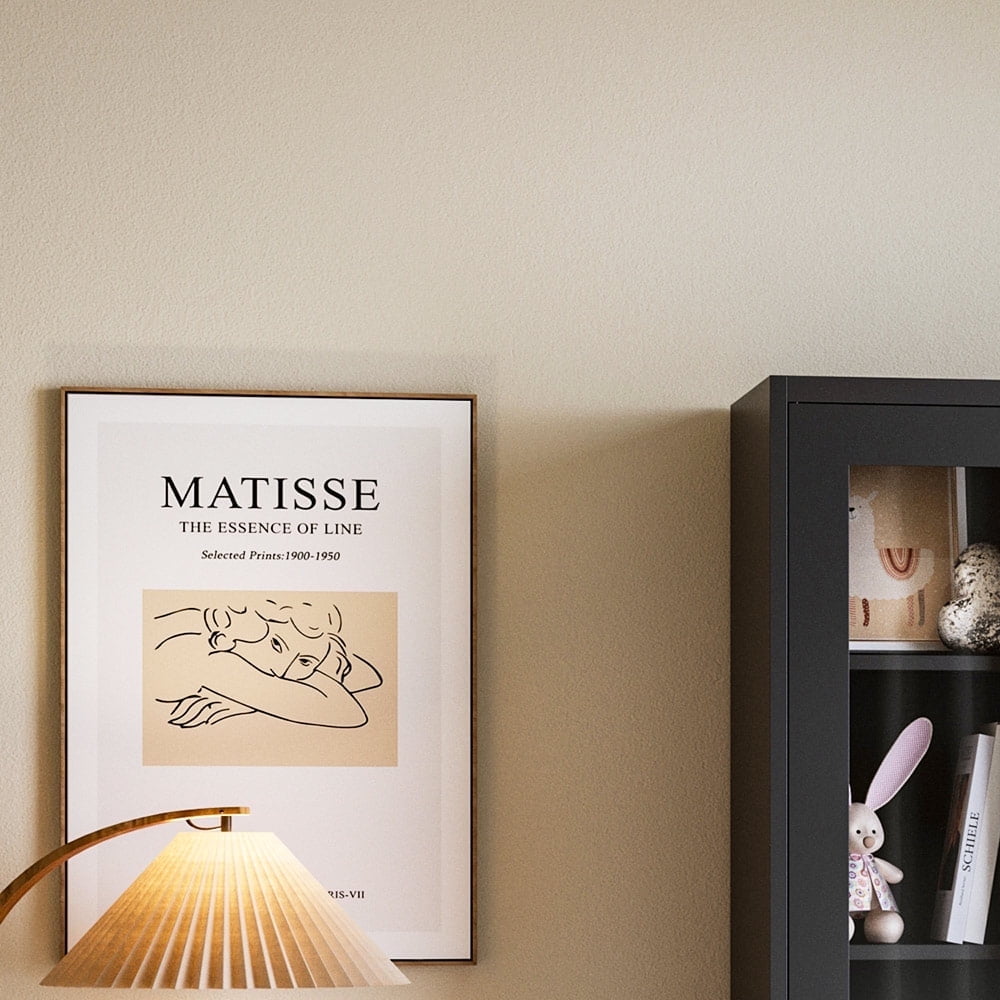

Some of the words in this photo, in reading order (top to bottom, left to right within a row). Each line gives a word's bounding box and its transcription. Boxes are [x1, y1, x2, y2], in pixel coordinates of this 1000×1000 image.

[161, 475, 381, 511] MATISSE
[179, 521, 212, 533] THE
[218, 521, 292, 535] ESSENCE
[297, 522, 319, 535] OF
[324, 523, 363, 536] LINE
[201, 550, 246, 561] Selected
[962, 811, 980, 872] SCHIELE
